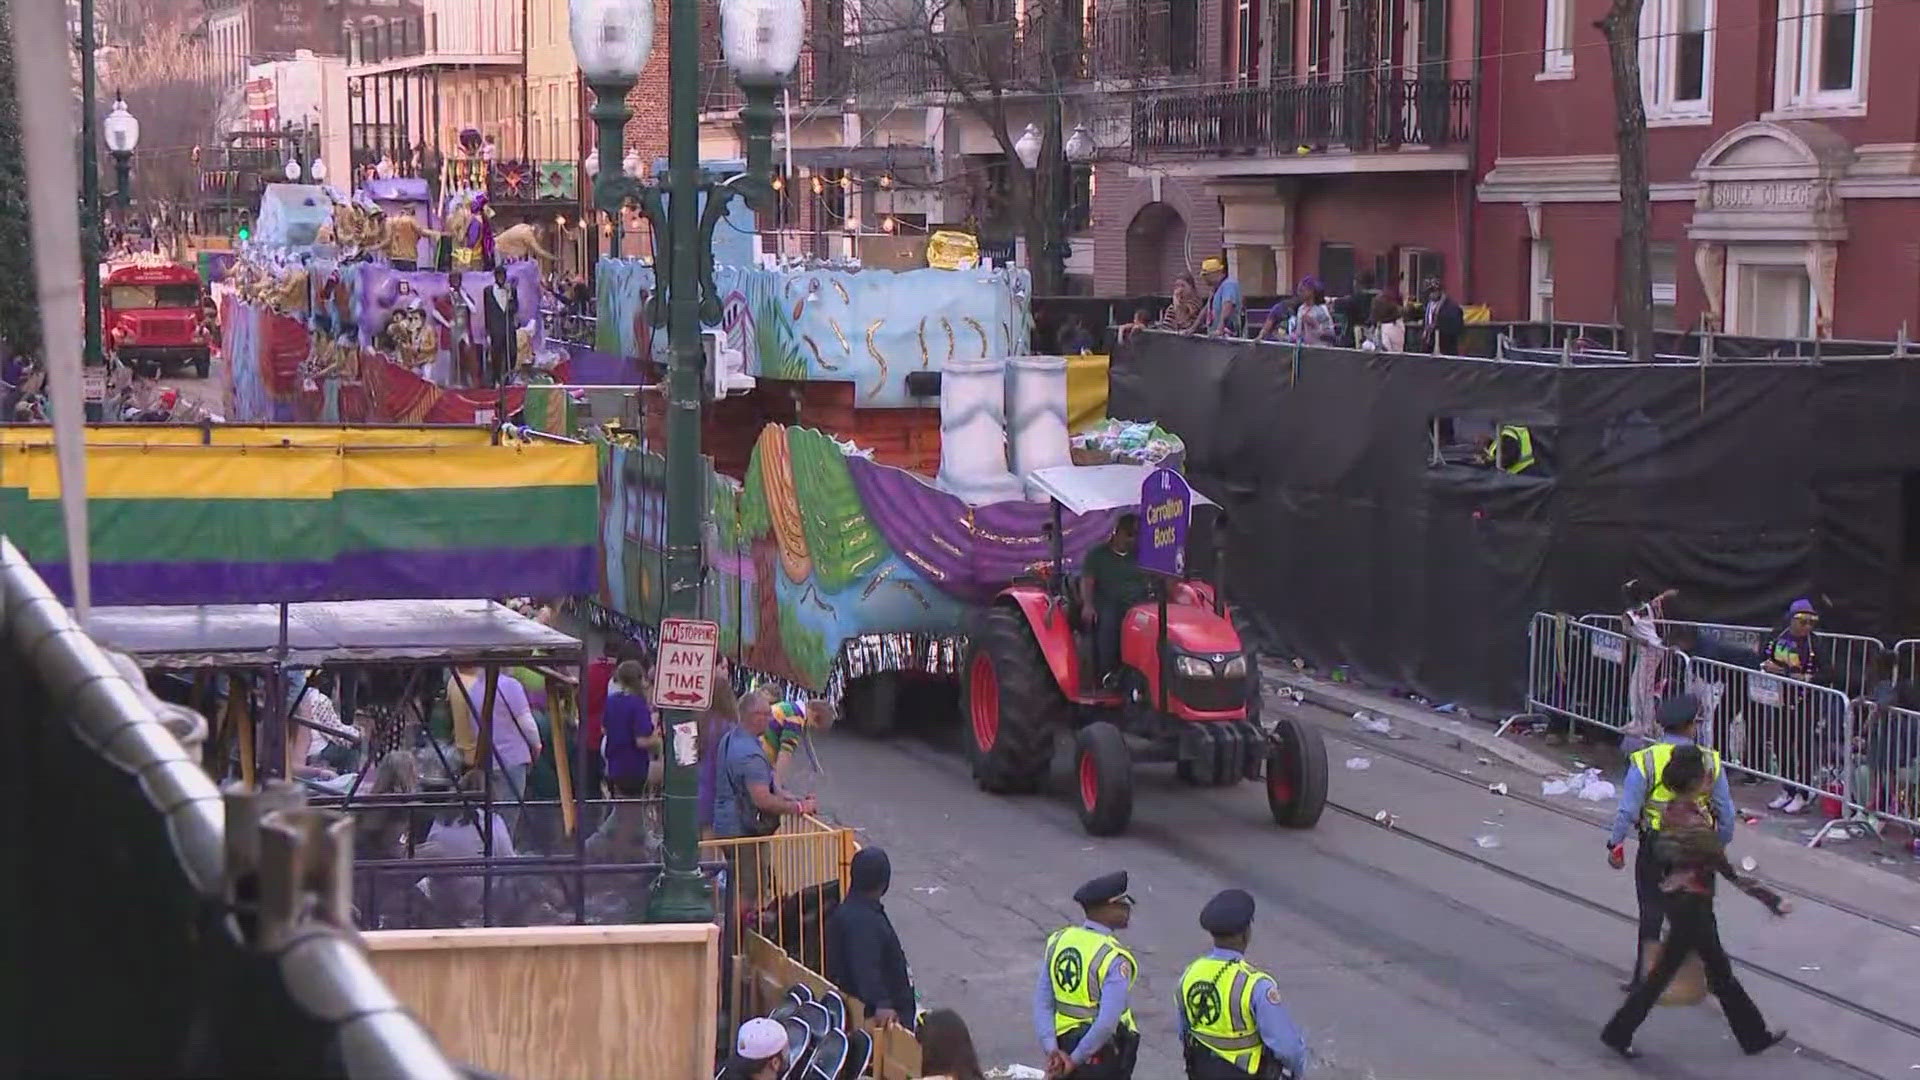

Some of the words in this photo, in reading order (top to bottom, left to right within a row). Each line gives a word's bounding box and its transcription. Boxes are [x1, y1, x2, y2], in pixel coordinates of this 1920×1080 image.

[1762, 183, 1812, 206] COLLEGE
[1146, 498, 1184, 525] Carrollton
[1154, 527, 1176, 549] Boots
[663, 623, 679, 641] NO
[680, 624, 714, 641] STOPPING
[670, 651, 705, 667] ANY
[666, 673, 705, 690] TIME
